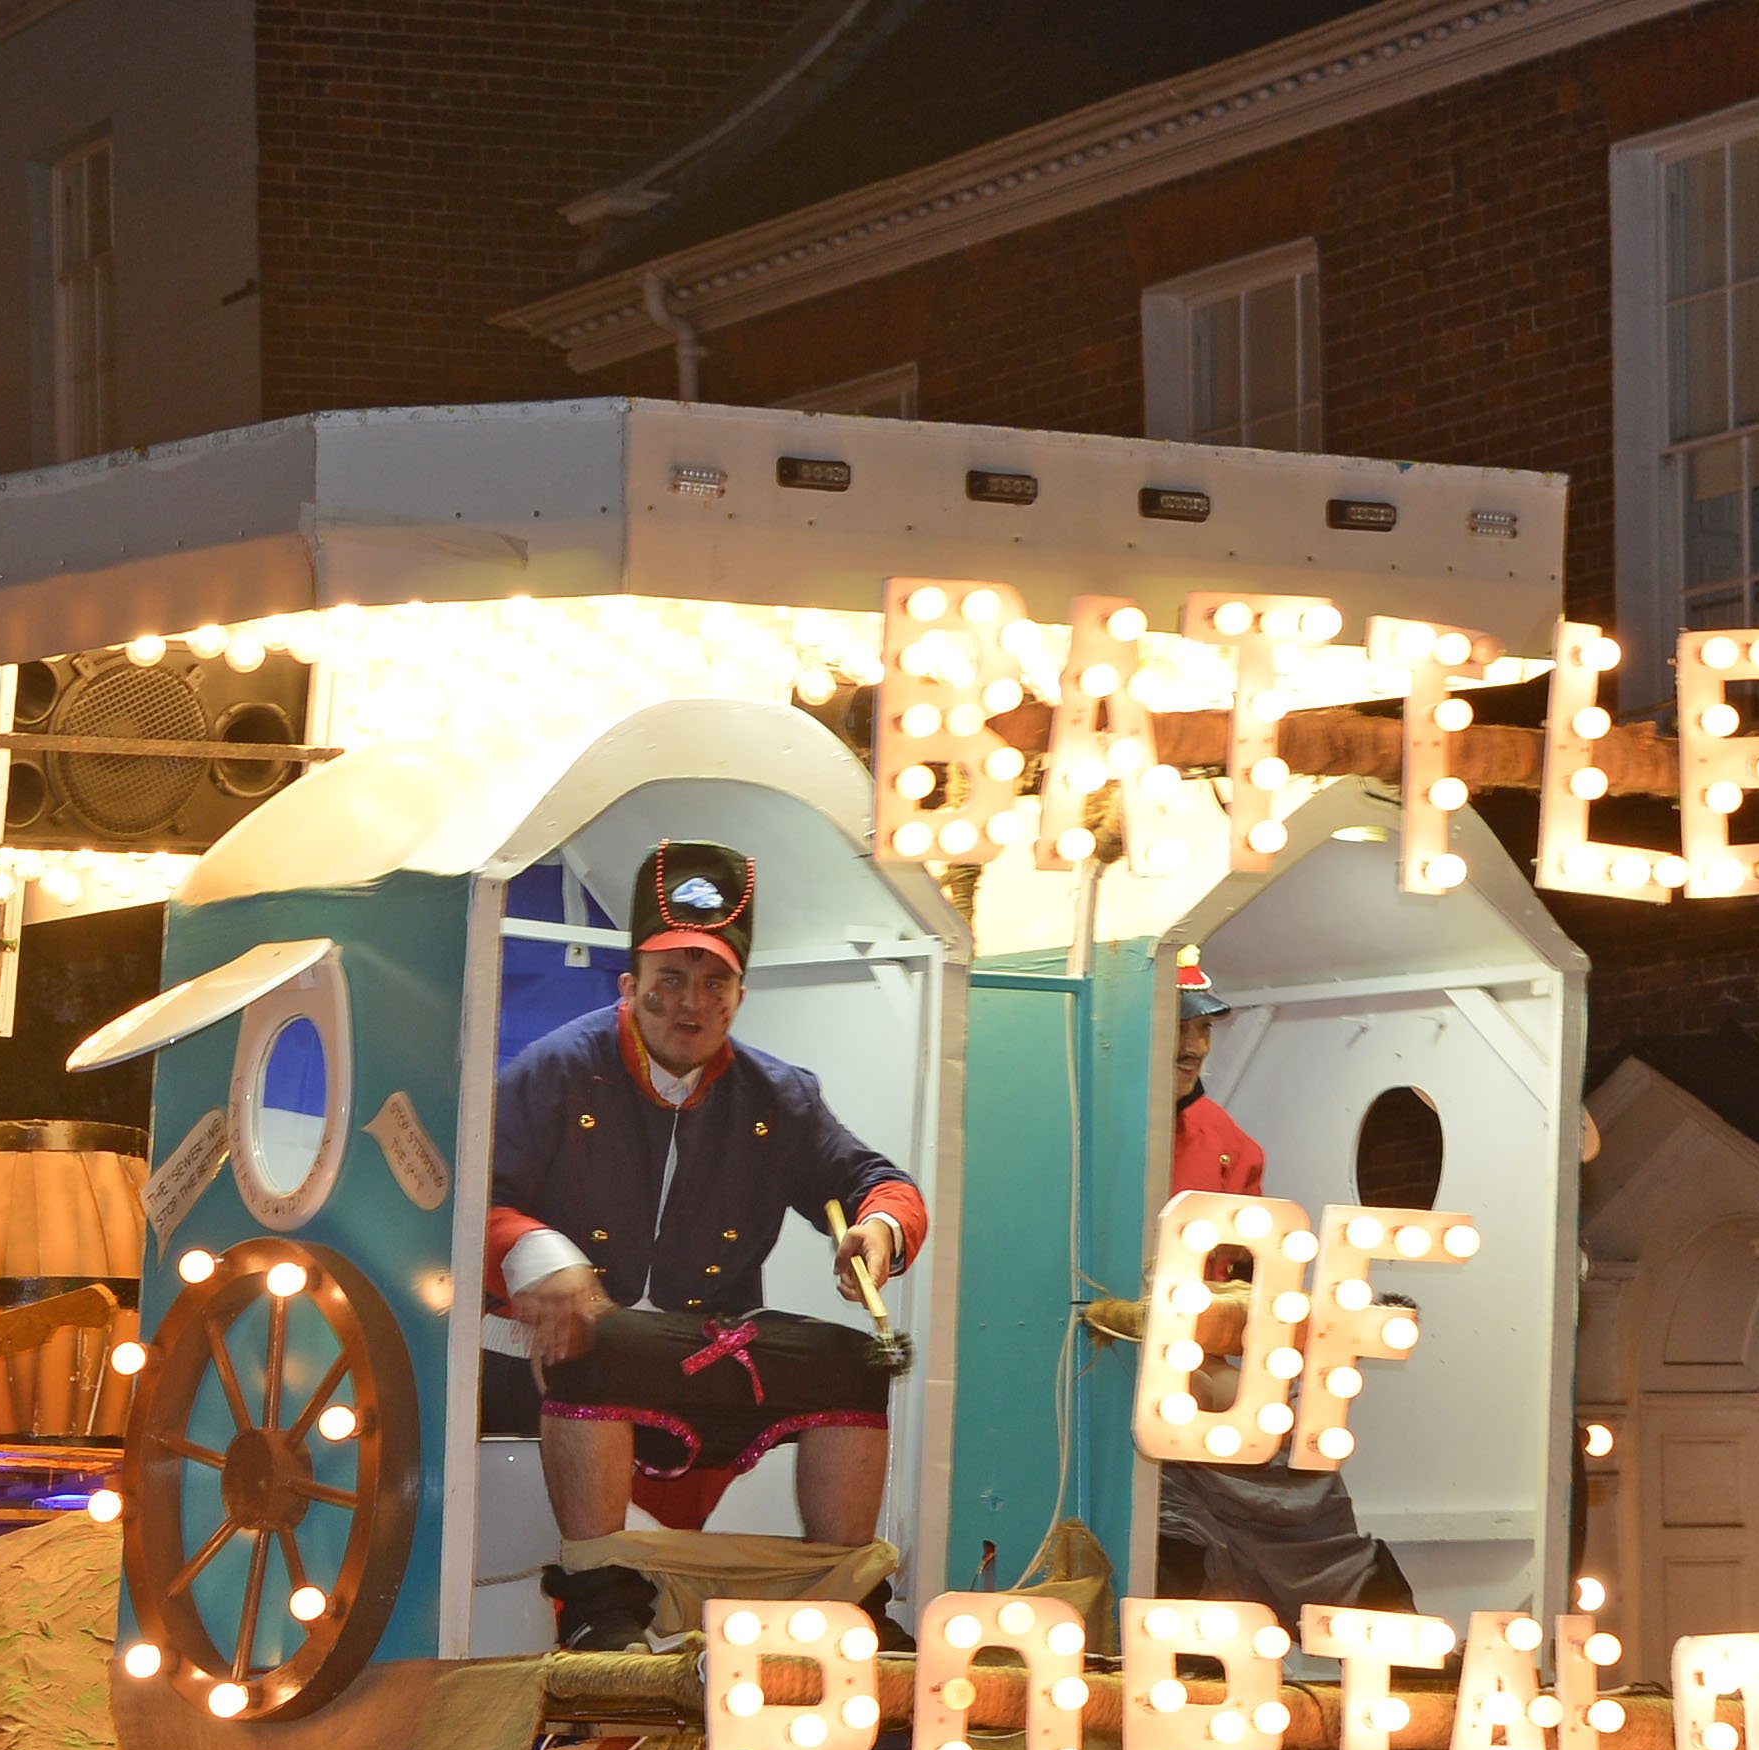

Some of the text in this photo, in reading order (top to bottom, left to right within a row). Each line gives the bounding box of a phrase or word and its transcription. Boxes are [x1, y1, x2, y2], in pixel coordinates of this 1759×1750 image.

[146, 1180, 169, 1205] THE
[205, 1117, 223, 1143] WE
[154, 1195, 178, 1228] STOP
[179, 1173, 197, 1198] THE
[1131, 1189, 1483, 1471] OF
